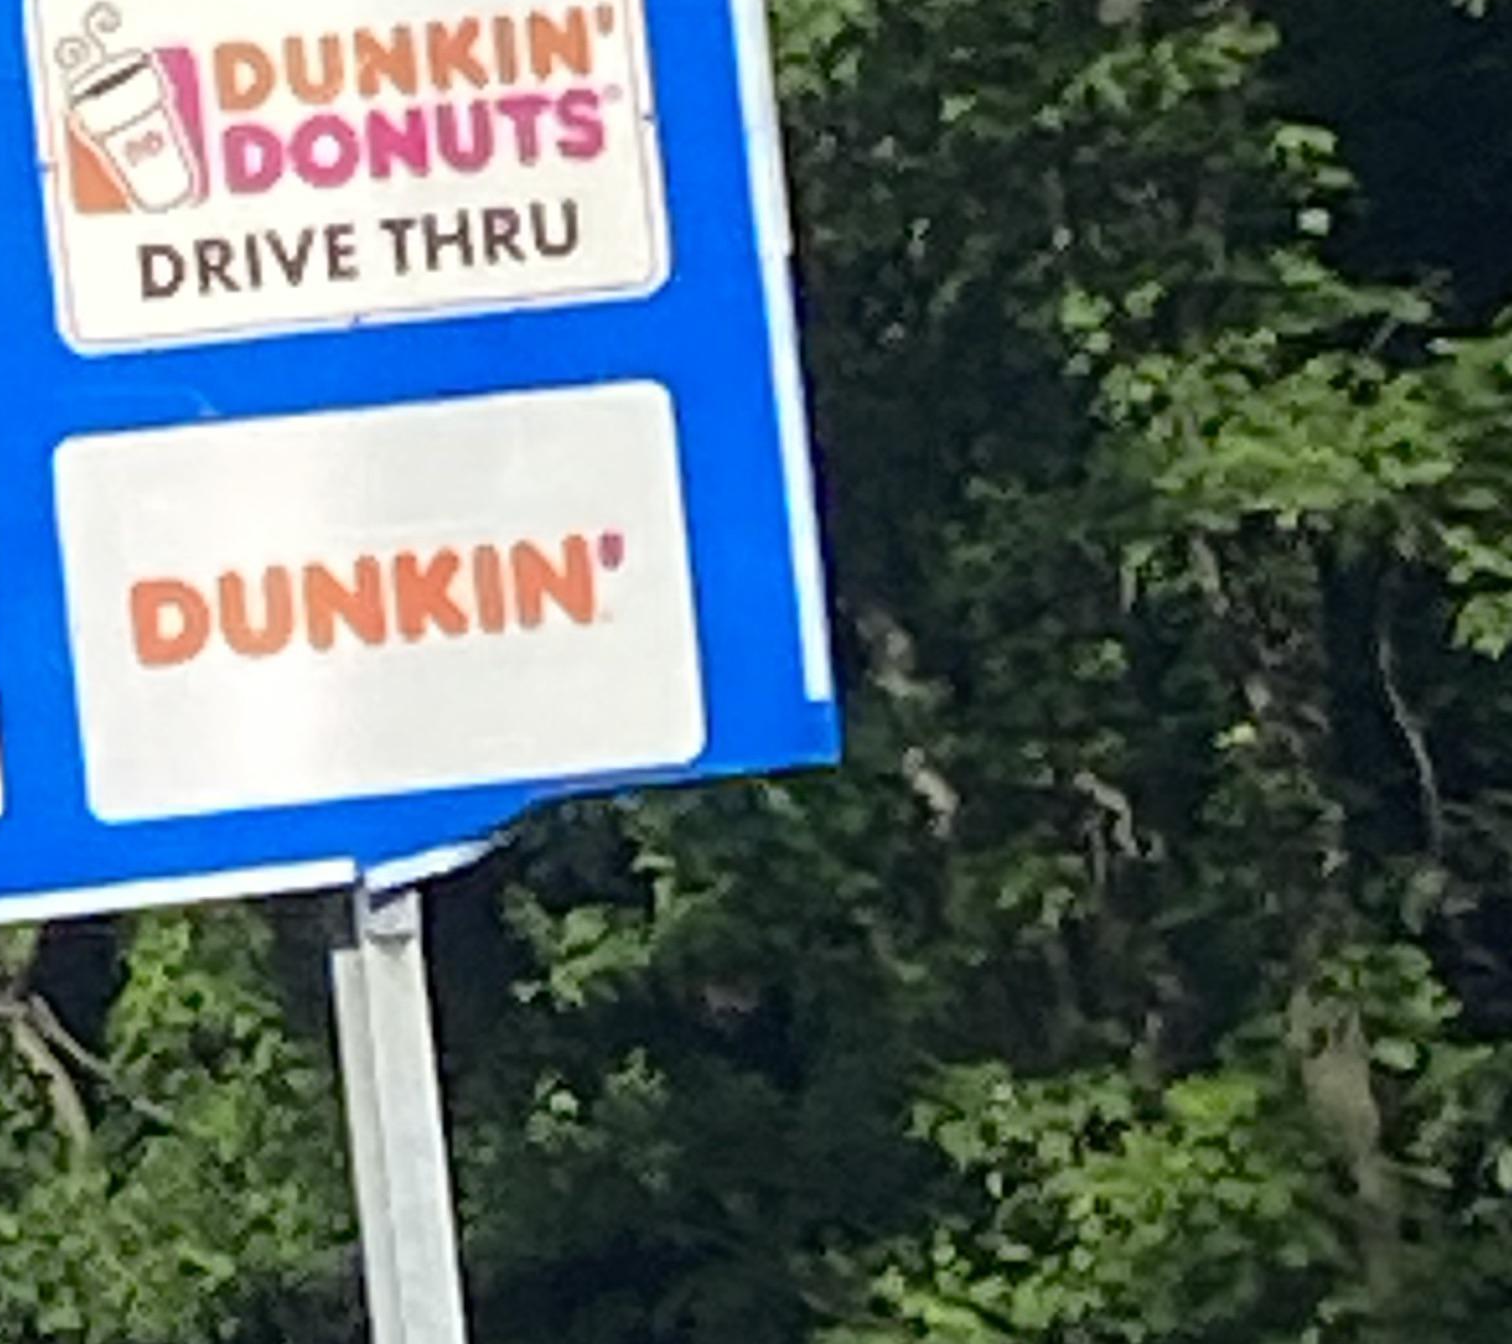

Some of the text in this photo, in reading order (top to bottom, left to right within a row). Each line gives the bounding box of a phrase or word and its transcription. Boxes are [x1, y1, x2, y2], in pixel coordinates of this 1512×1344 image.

[213, 4, 615, 113] DUNKIN'
[221, 87, 607, 196] DONUTS
[138, 198, 580, 302] DRIVE THRU
[128, 531, 625, 668] DUNKIN'
